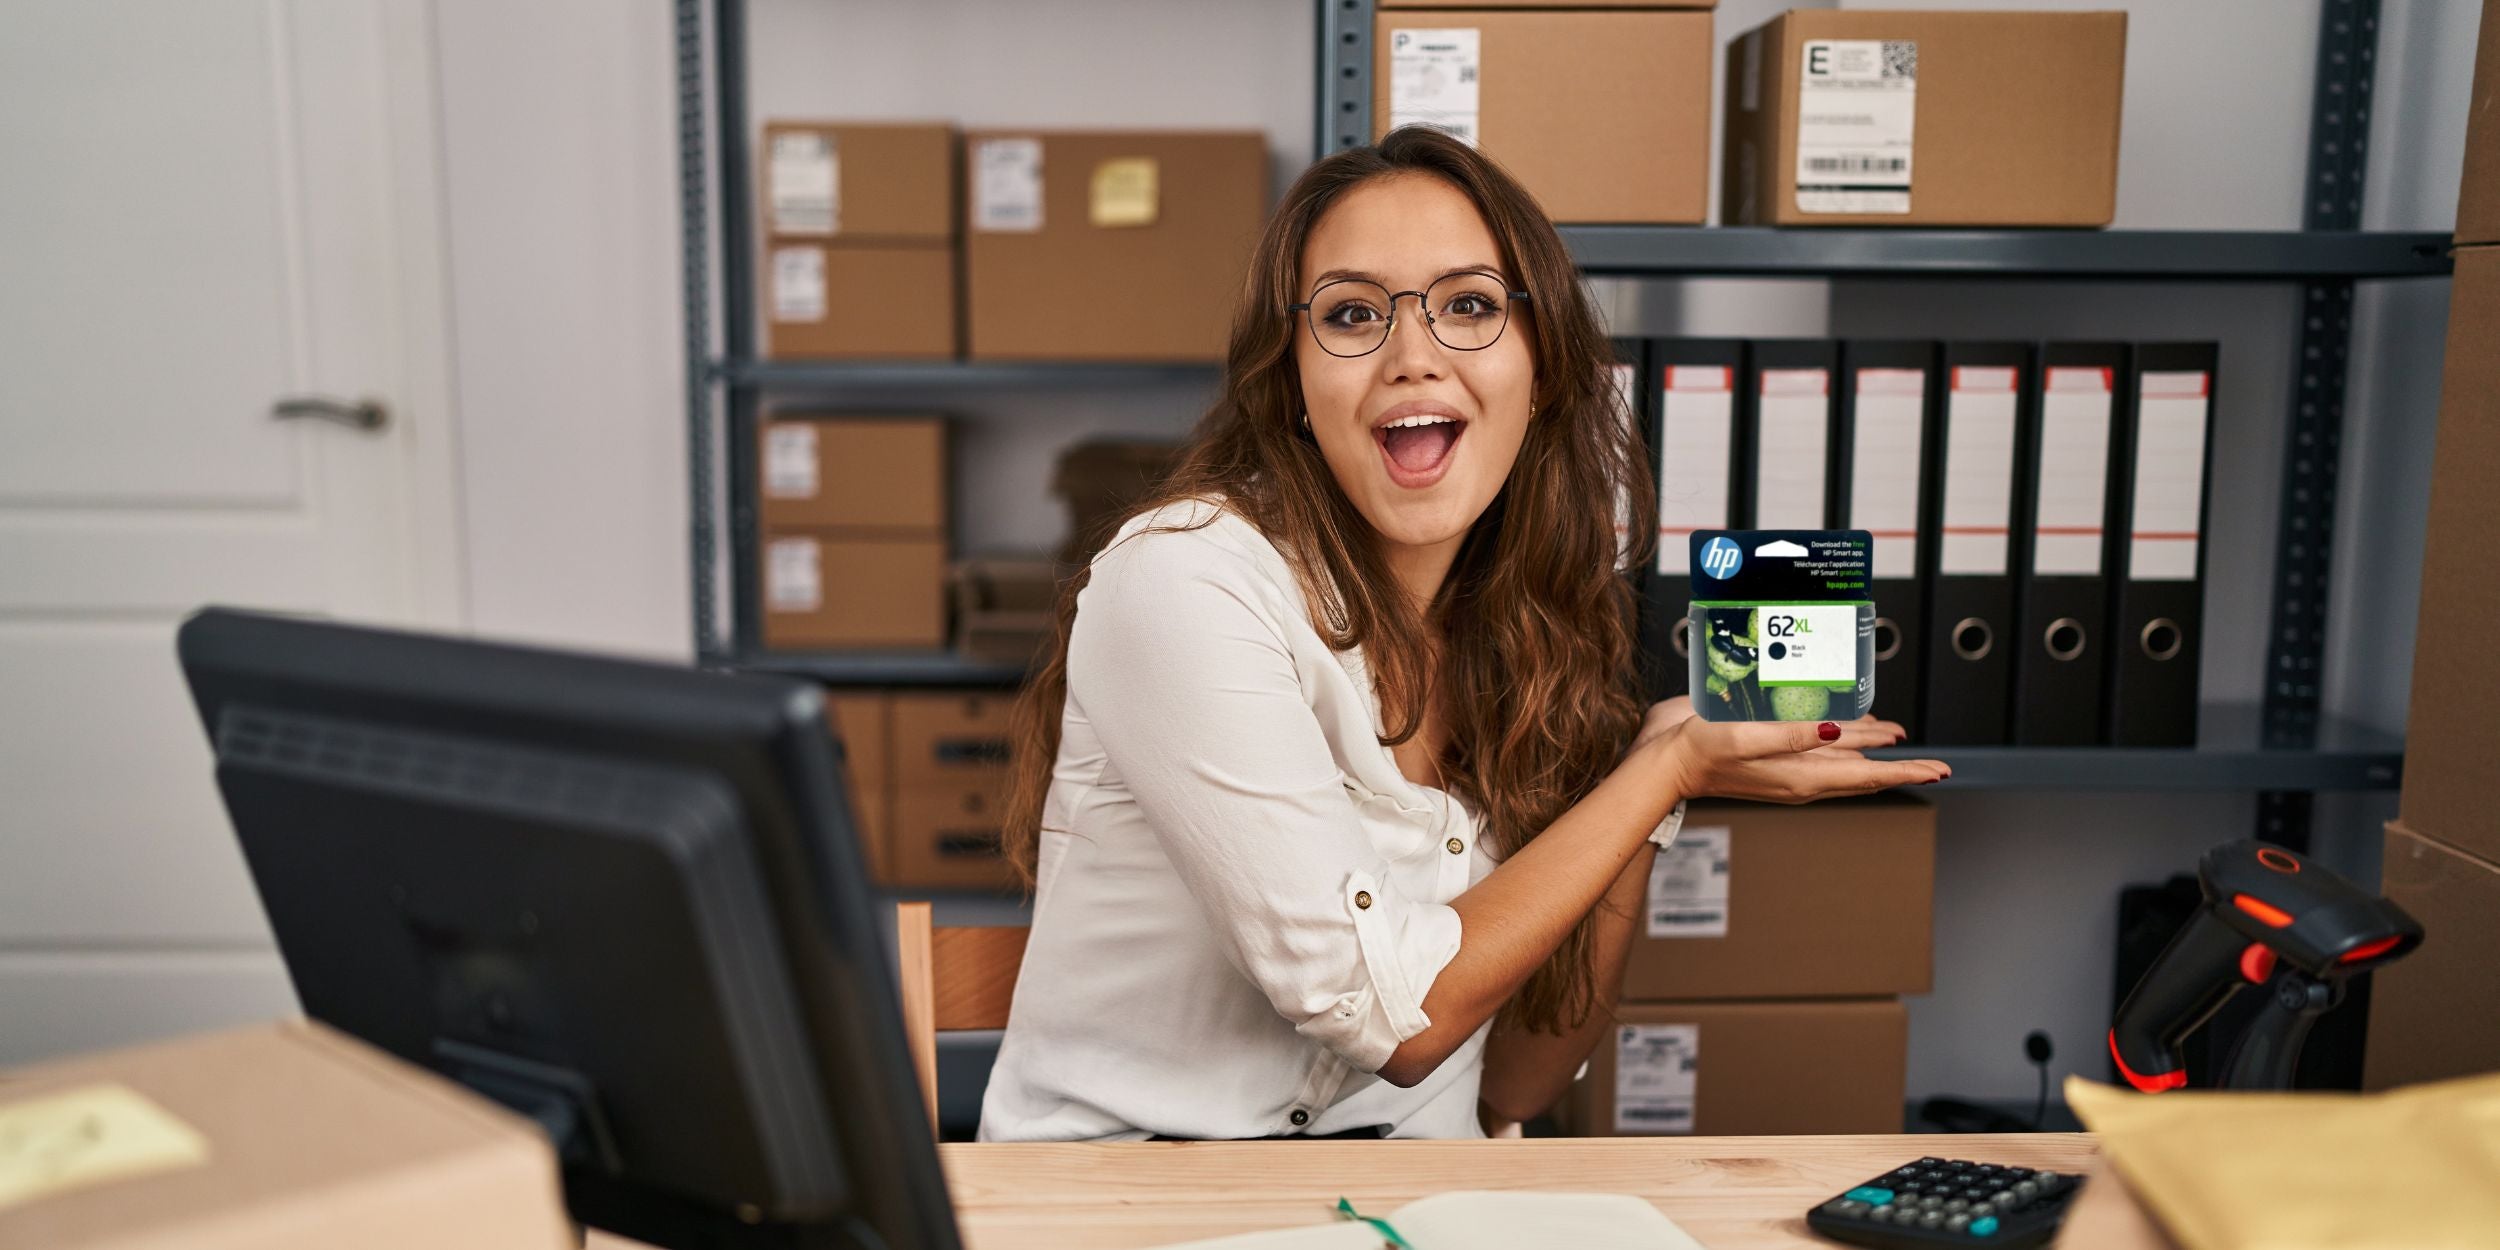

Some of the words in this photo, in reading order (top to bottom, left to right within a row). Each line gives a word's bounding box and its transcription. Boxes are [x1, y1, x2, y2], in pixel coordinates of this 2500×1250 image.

[1809, 46, 1829, 75] E
[1705, 537, 1739, 579] hp
[1826, 581, 1865, 590] hpapp.com
